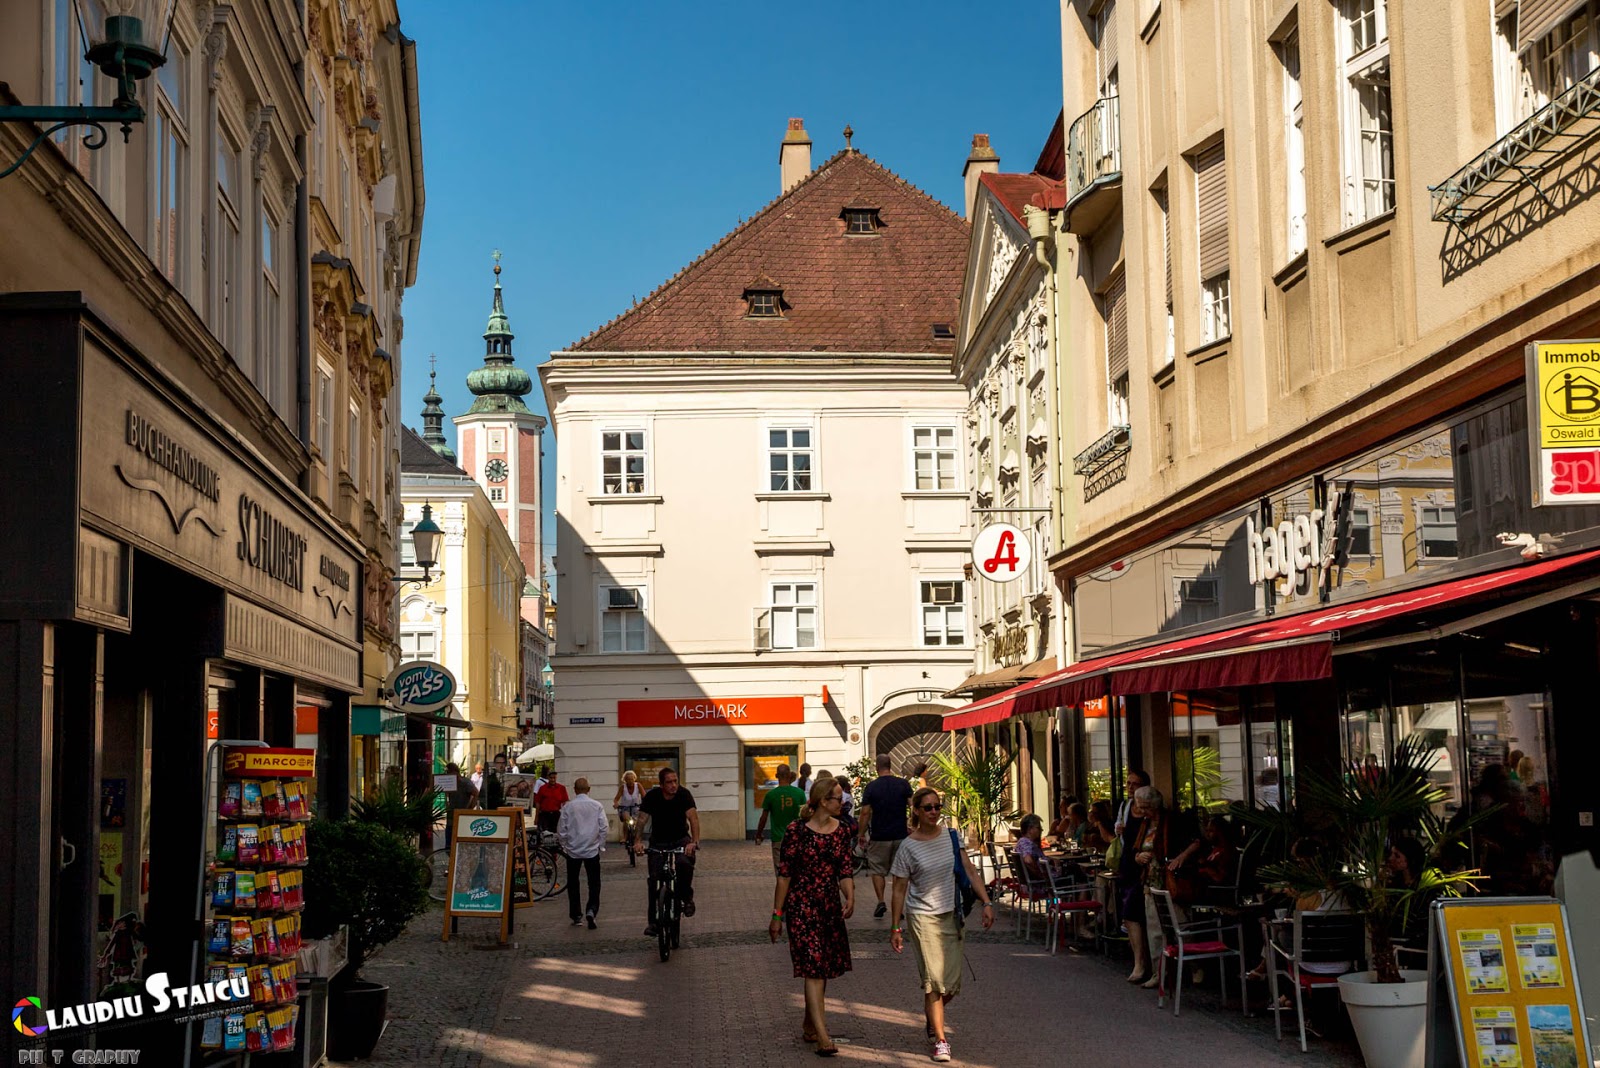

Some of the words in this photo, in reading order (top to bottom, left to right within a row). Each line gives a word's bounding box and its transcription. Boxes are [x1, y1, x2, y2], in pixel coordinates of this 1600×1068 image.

[1550, 428, 1594, 439] Oswald
[126, 409, 221, 503] BUCHHANDLUNG
[237, 492, 307, 593] SCHUBERT
[1246, 508, 1323, 596] hager
[399, 671, 422, 688] vom
[399, 673, 444, 705] FASS
[674, 703, 748, 719] McSHARK
[253, 757, 297, 766] MARCO
[472, 821, 494, 835] FASS
[470, 890, 489, 900] FASS
[227, 1026, 244, 1034] ERN
